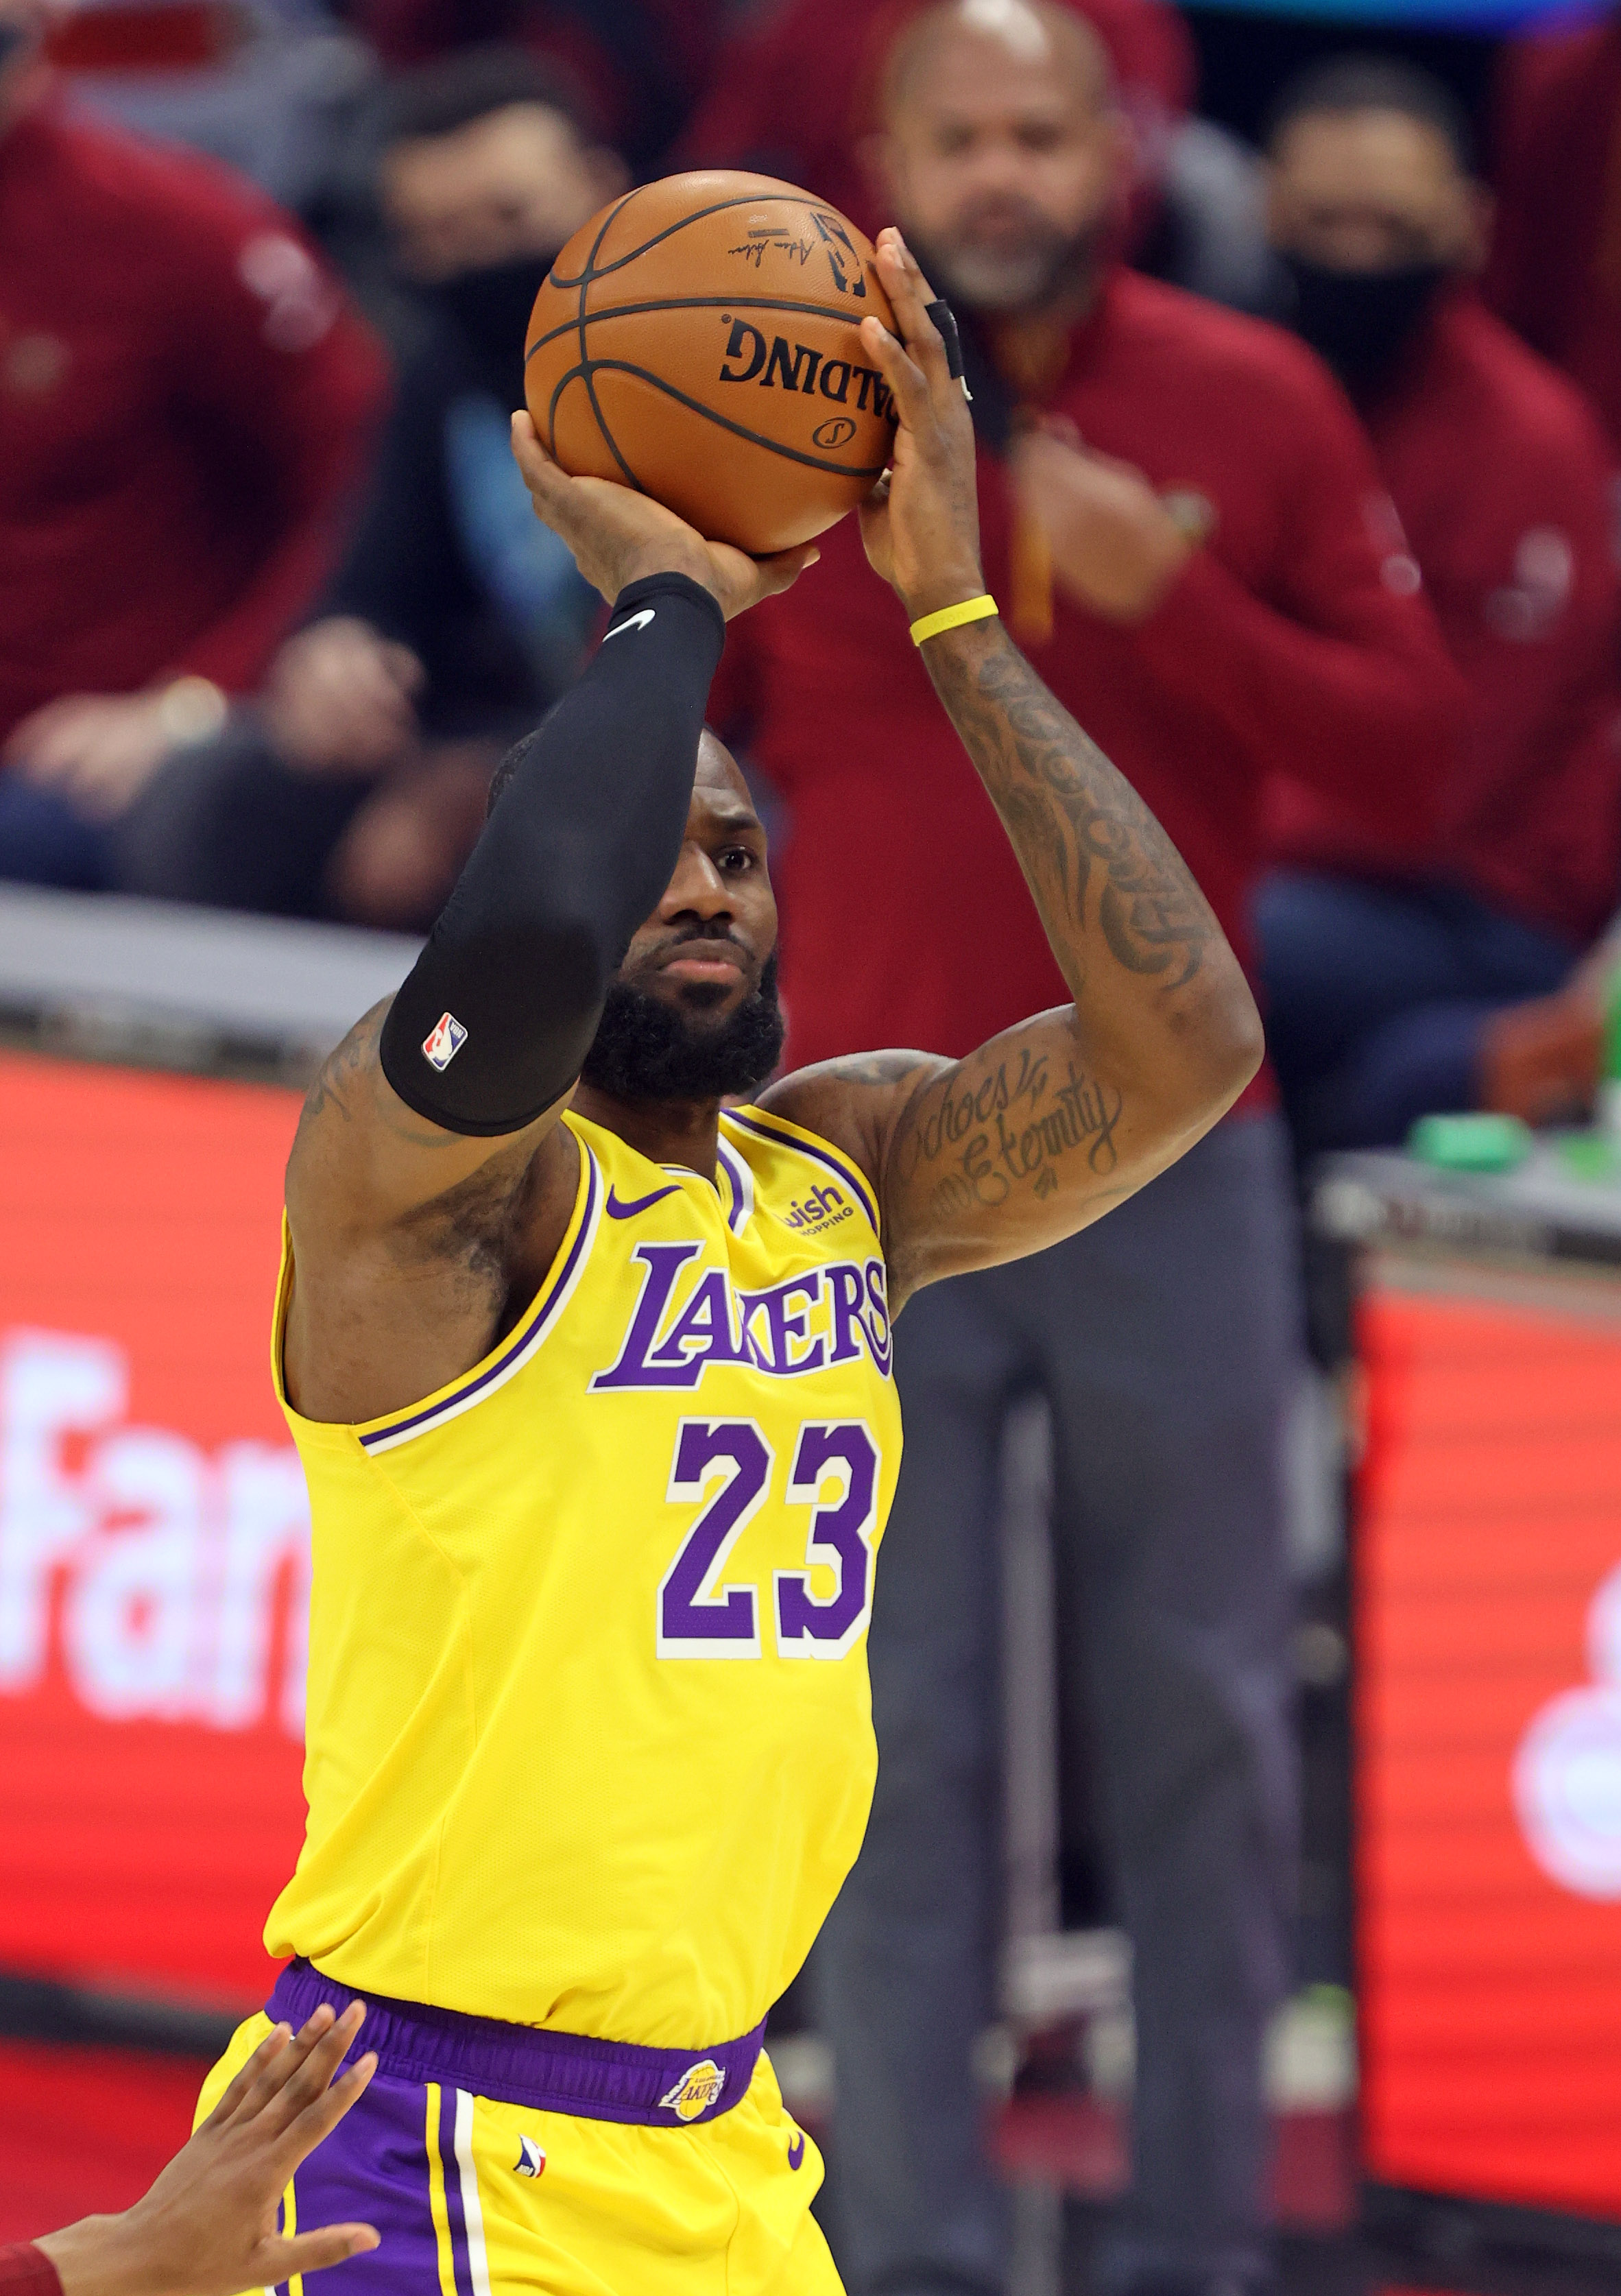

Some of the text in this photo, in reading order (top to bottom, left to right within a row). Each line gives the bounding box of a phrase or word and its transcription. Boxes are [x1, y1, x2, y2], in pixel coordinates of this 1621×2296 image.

[450, 1022, 464, 1039] NBA
[800, 1206, 854, 1236] HOPPING
[586, 1239, 892, 1394] LAKERS
[656, 1415, 882, 1660] 23
